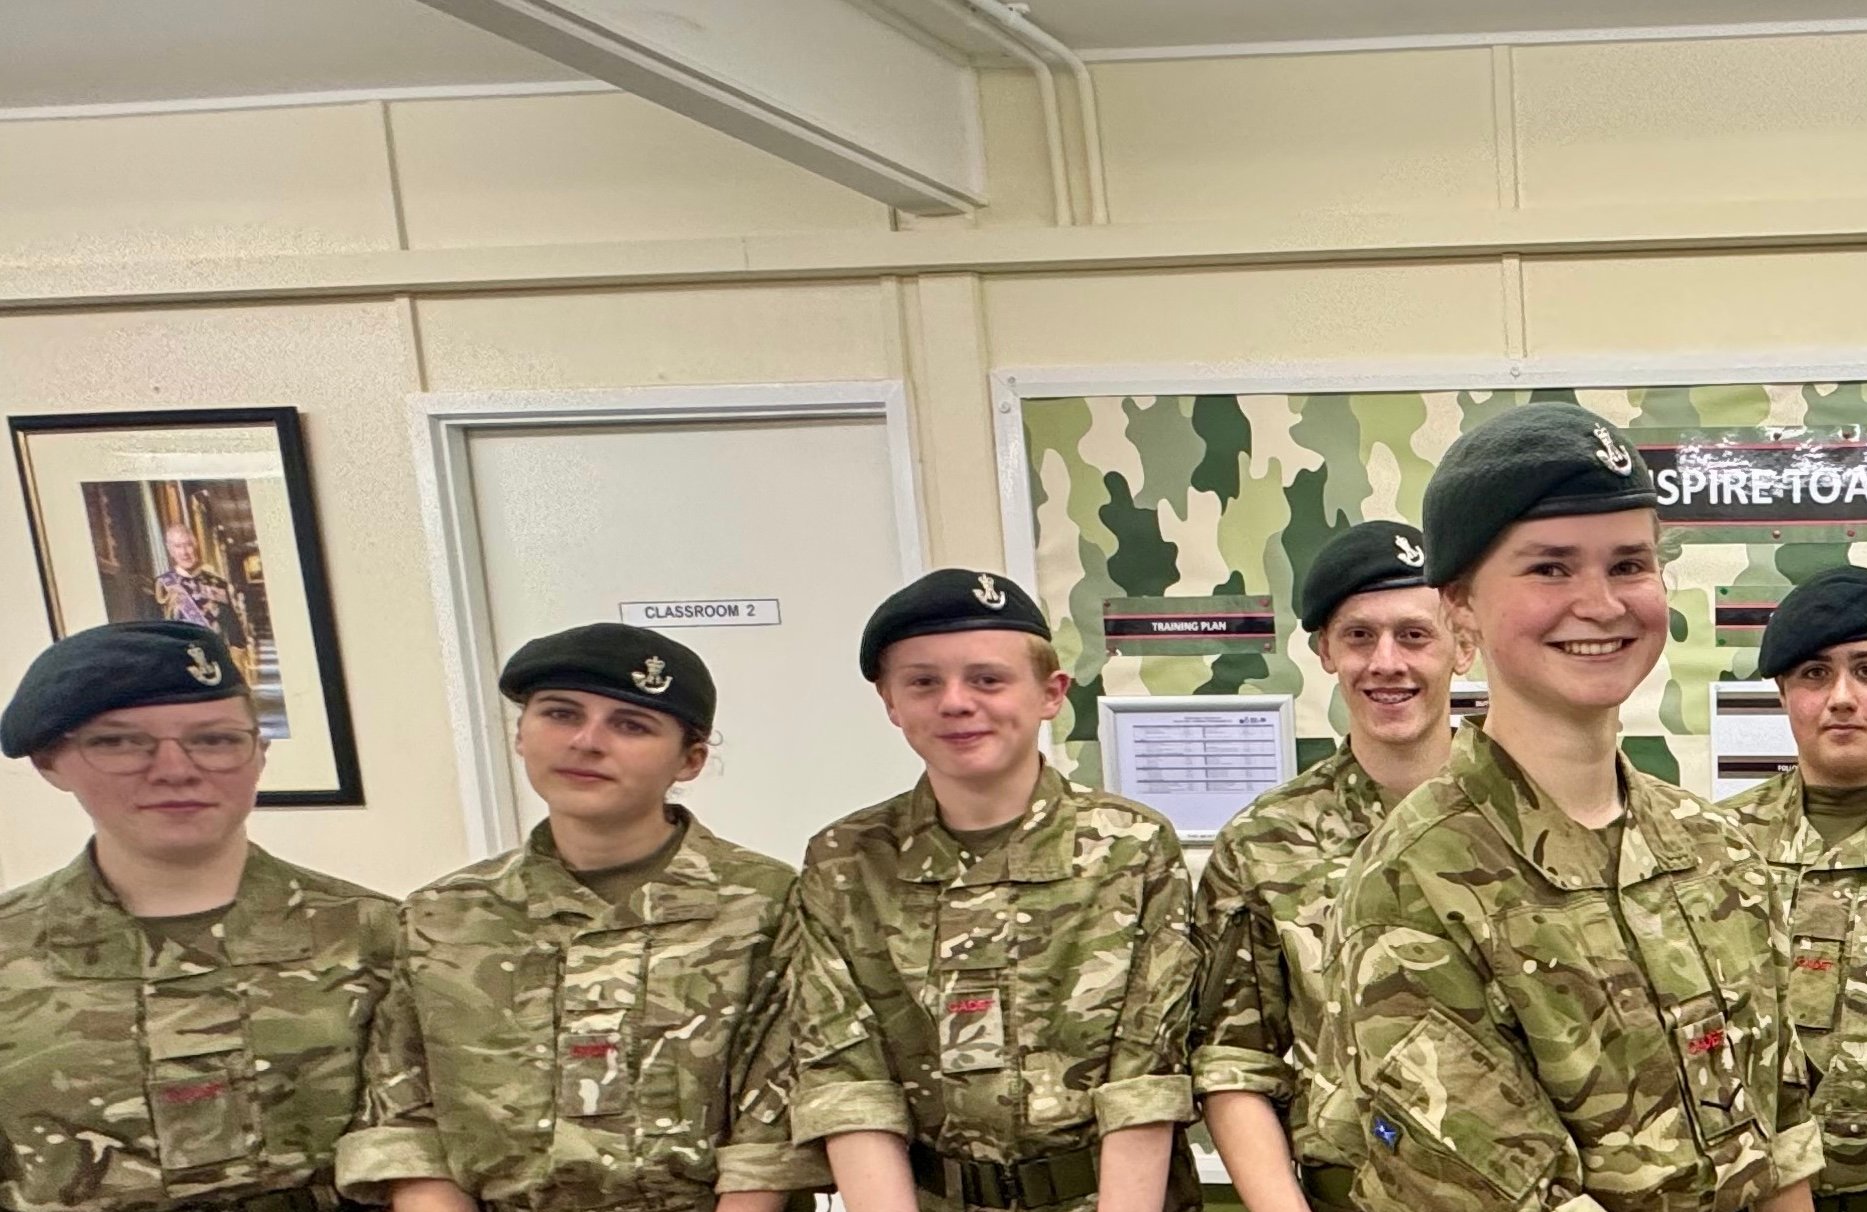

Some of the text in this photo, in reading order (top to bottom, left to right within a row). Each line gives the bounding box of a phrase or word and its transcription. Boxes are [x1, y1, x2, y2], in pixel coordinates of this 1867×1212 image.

[1648, 468, 1773, 506] SPIRE
[645, 604, 756, 619] CLASSROOM 2
[1152, 621, 1227, 632] TRAINING PLAN
